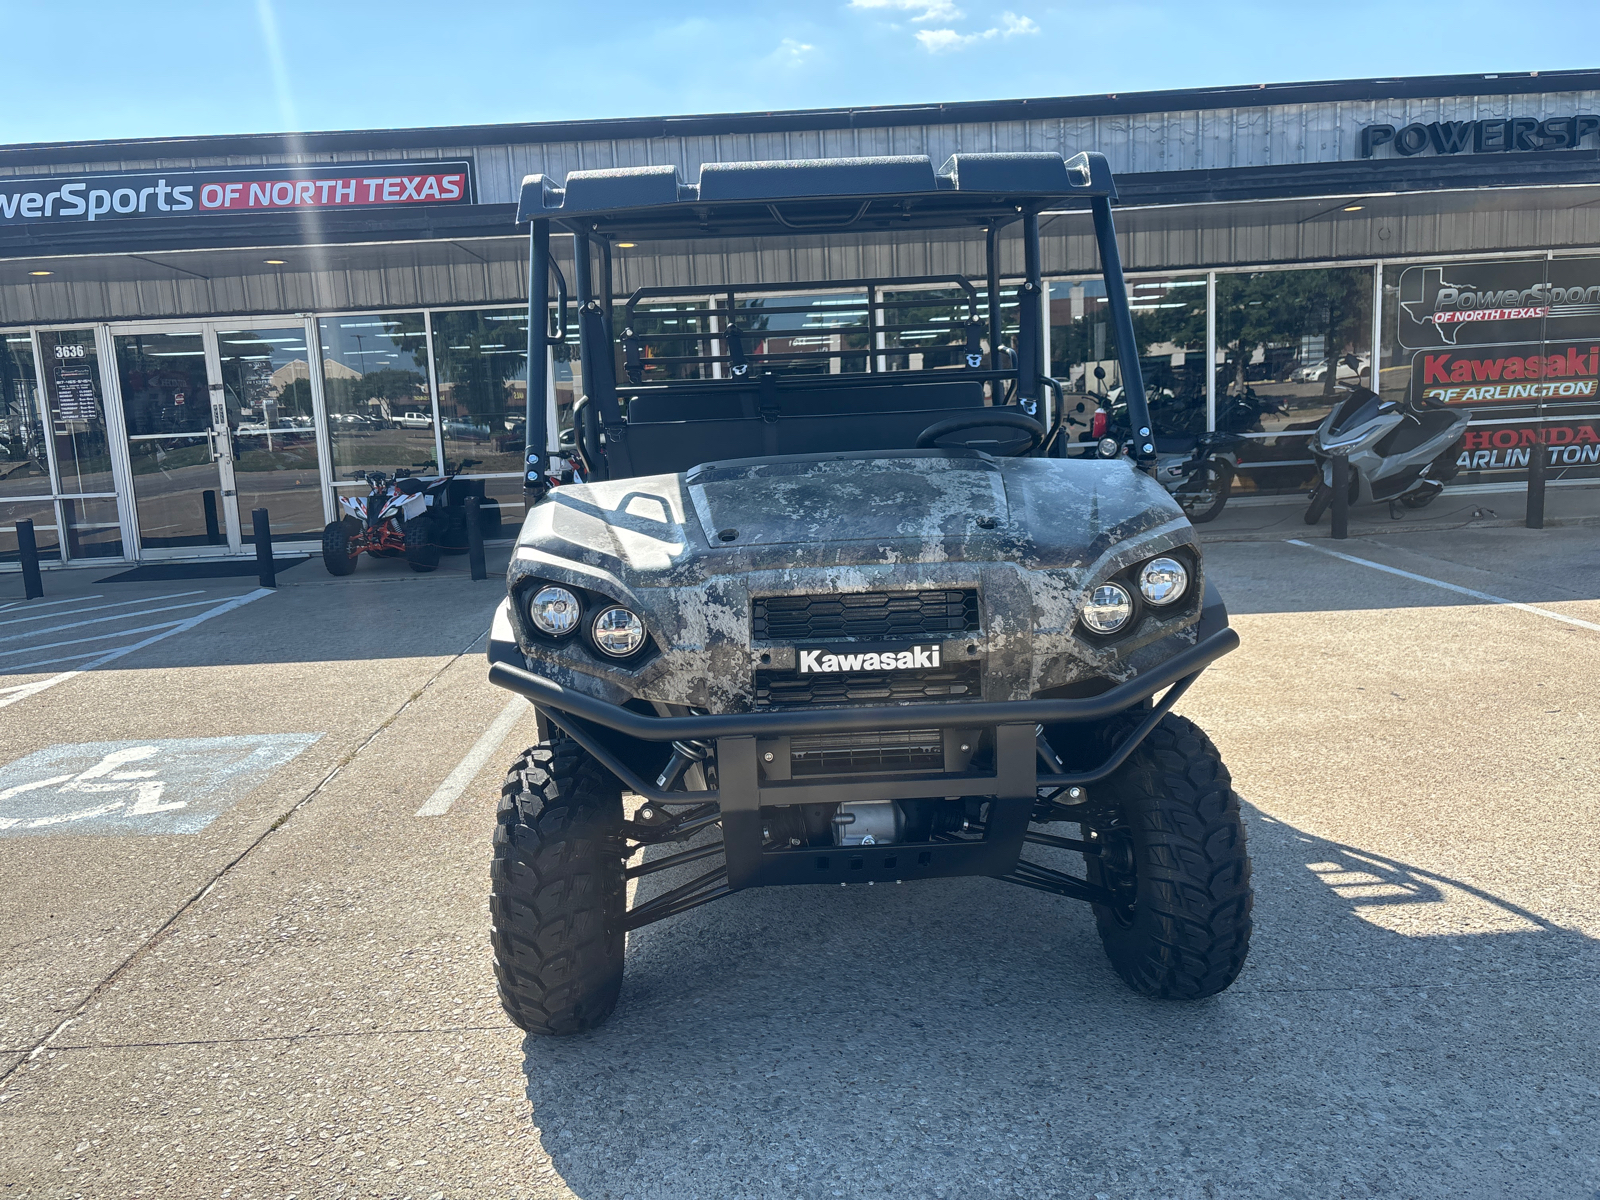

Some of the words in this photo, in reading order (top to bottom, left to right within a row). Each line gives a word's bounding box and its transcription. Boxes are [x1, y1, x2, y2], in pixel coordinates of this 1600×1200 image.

[201, 184, 243, 207] OF
[249, 180, 356, 206] NORTH
[363, 175, 460, 201] TEXAS
[1434, 282, 1600, 311] PowerSpor
[1434, 312, 1452, 322] OF
[1454, 309, 1500, 321] NORTH
[1503, 306, 1544, 318] TEXAS
[56, 346, 84, 357] 3636
[1424, 346, 1599, 384] Kawasaki
[1428, 388, 1460, 402] OF
[1461, 382, 1592, 401] ARLINGTON
[1463, 425, 1600, 449] HONDA
[1456, 444, 1600, 469] ARLINTON
[800, 645, 940, 673] Kawasaki
